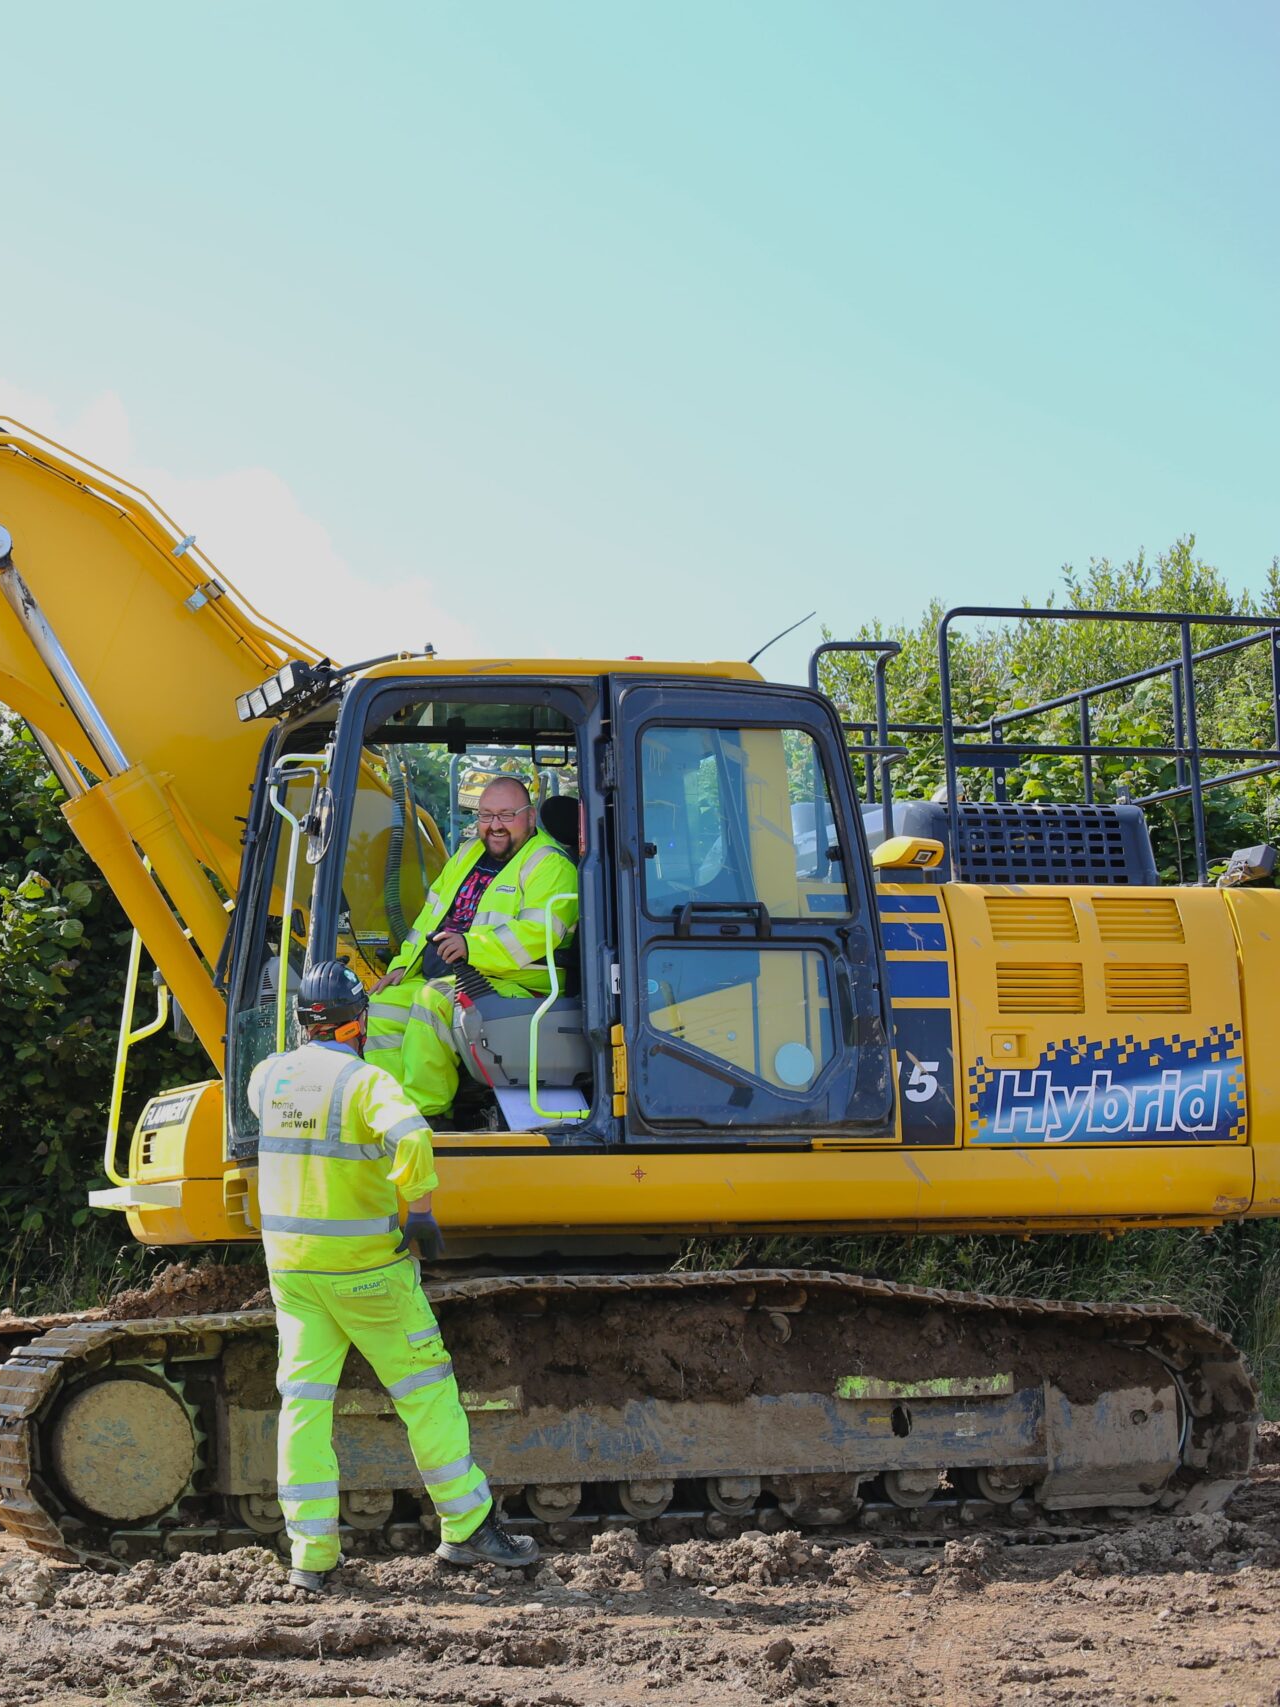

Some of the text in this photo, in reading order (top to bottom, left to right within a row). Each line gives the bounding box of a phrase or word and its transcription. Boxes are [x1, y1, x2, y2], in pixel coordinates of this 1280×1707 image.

[271, 1100, 294, 1110] home
[993, 1069, 1222, 1142] Hybrid
[143, 1097, 192, 1126] FLANNERY
[282, 1109, 303, 1119] safe
[281, 1118, 317, 1129] and well
